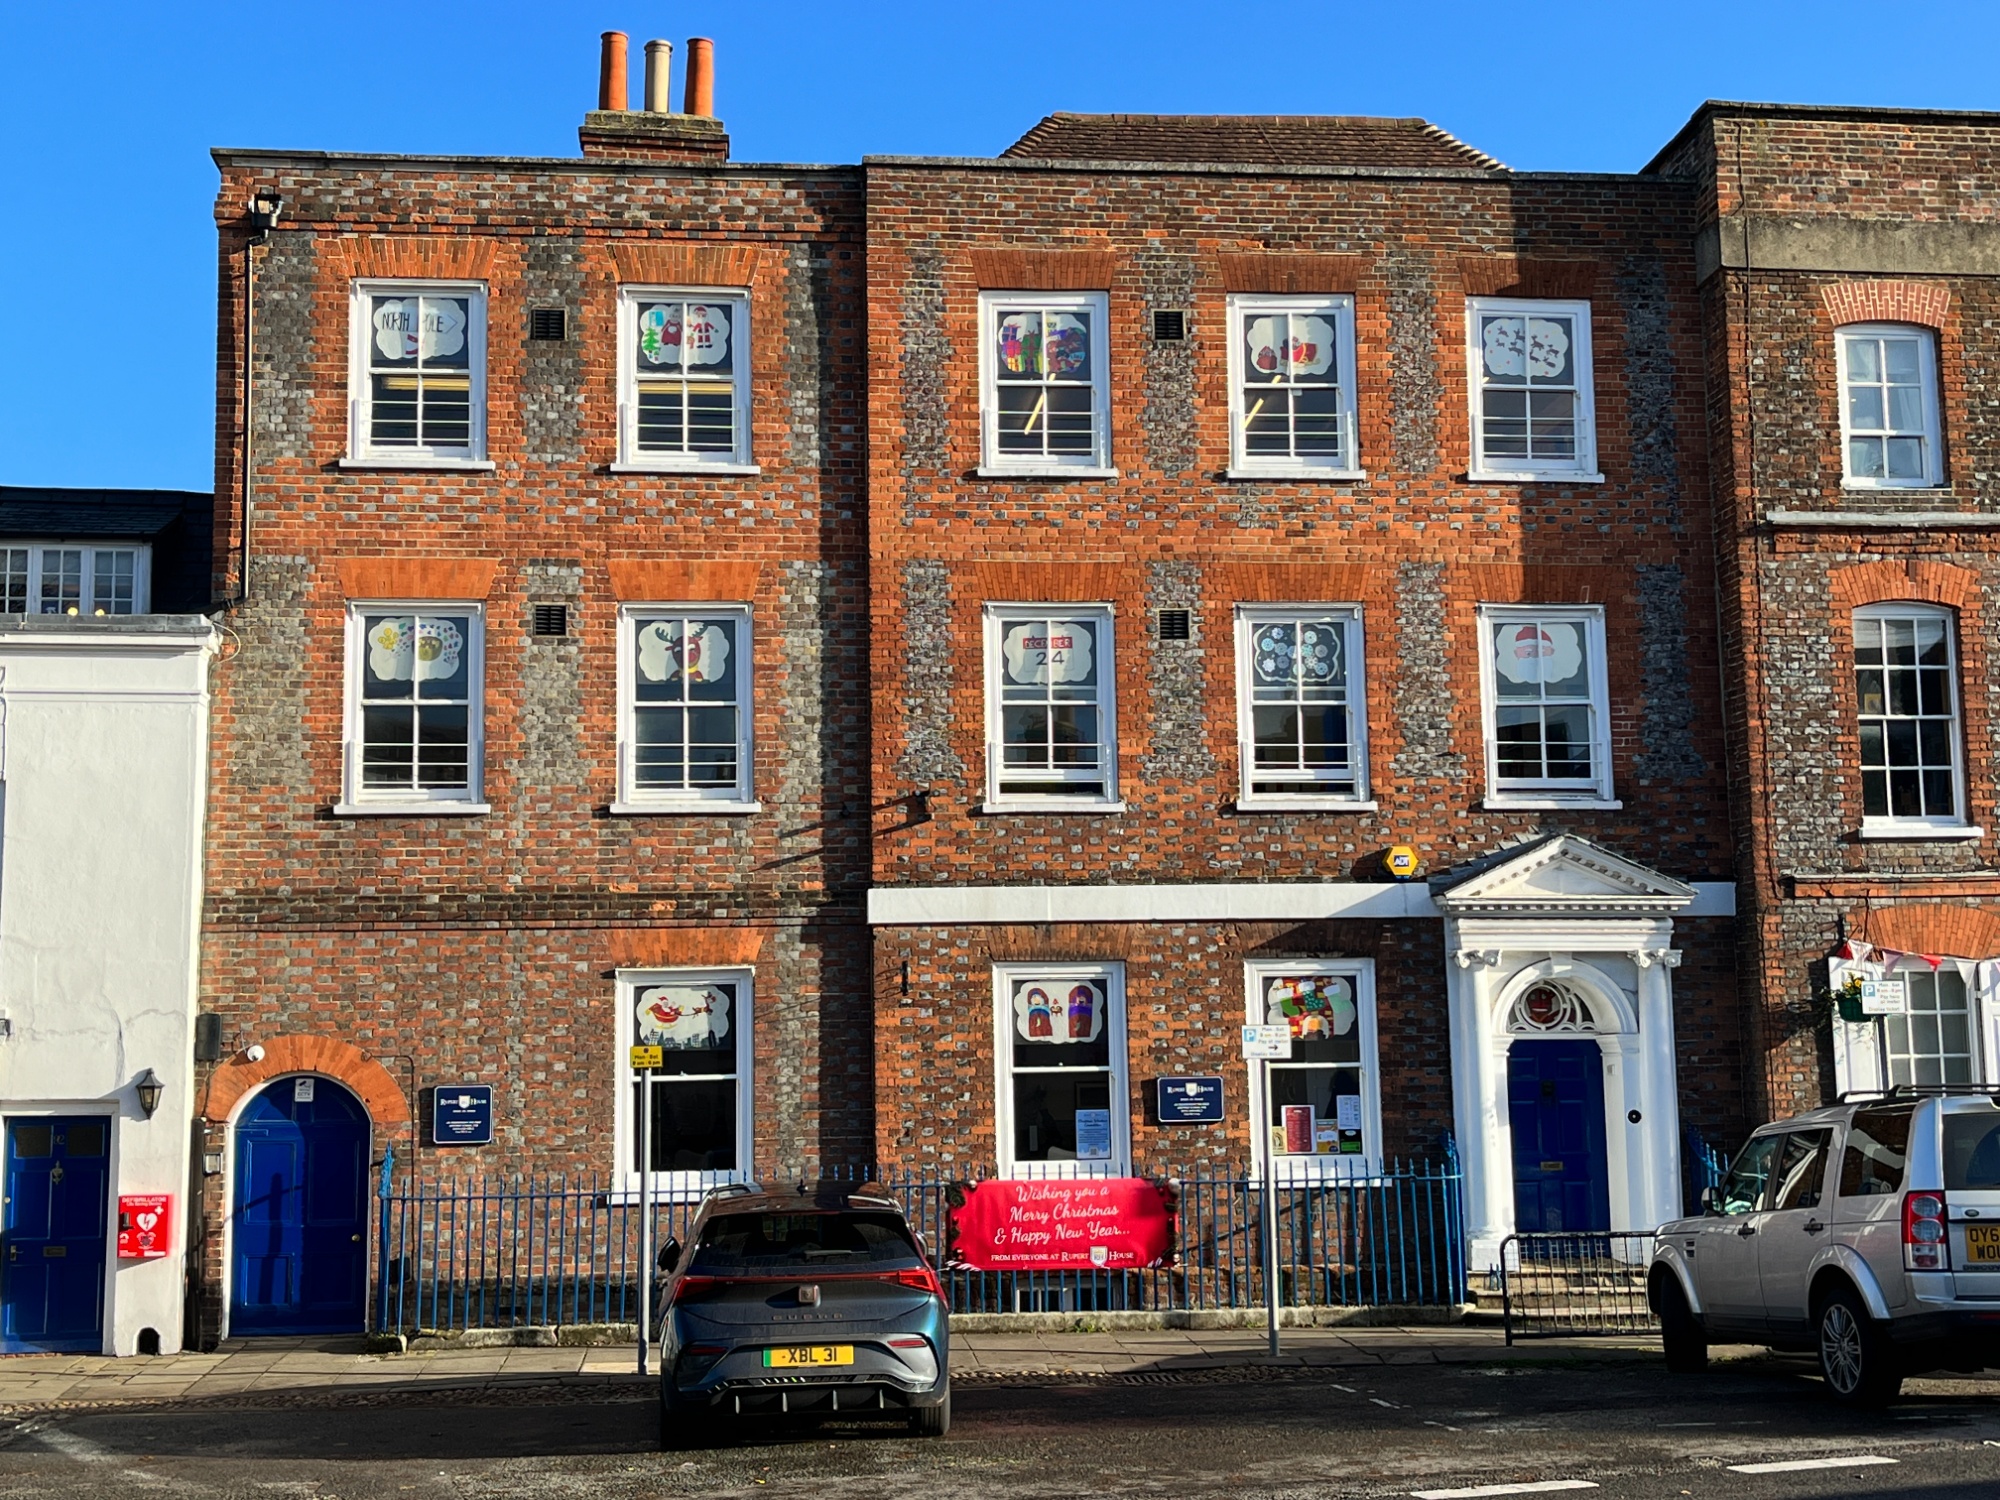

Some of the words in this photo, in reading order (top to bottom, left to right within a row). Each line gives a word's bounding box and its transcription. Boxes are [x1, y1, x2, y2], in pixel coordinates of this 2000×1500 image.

[382, 312, 410, 331] NORTH
[1025, 639, 1072, 649] DECEBER
[1036, 651, 1065, 666] 24
[1394, 856, 1408, 866] ADT
[1015, 1184, 1072, 1203] Wishing
[1074, 1187, 1097, 1202] you
[1100, 1186, 1109, 1196] a
[1009, 1206, 1050, 1225] Merry
[1053, 1203, 1119, 1220] Christmas
[994, 1228, 1007, 1245] &
[1011, 1227, 1051, 1245] Happy
[1055, 1223, 1084, 1240] New
[1087, 1221, 1130, 1240] Year...
[1061, 1252, 1089, 1262] RUPERT
[1108, 1251, 1134, 1260] HOUSE
[788, 1348, 818, 1363] XBL
[823, 1347, 837, 1362] 31
